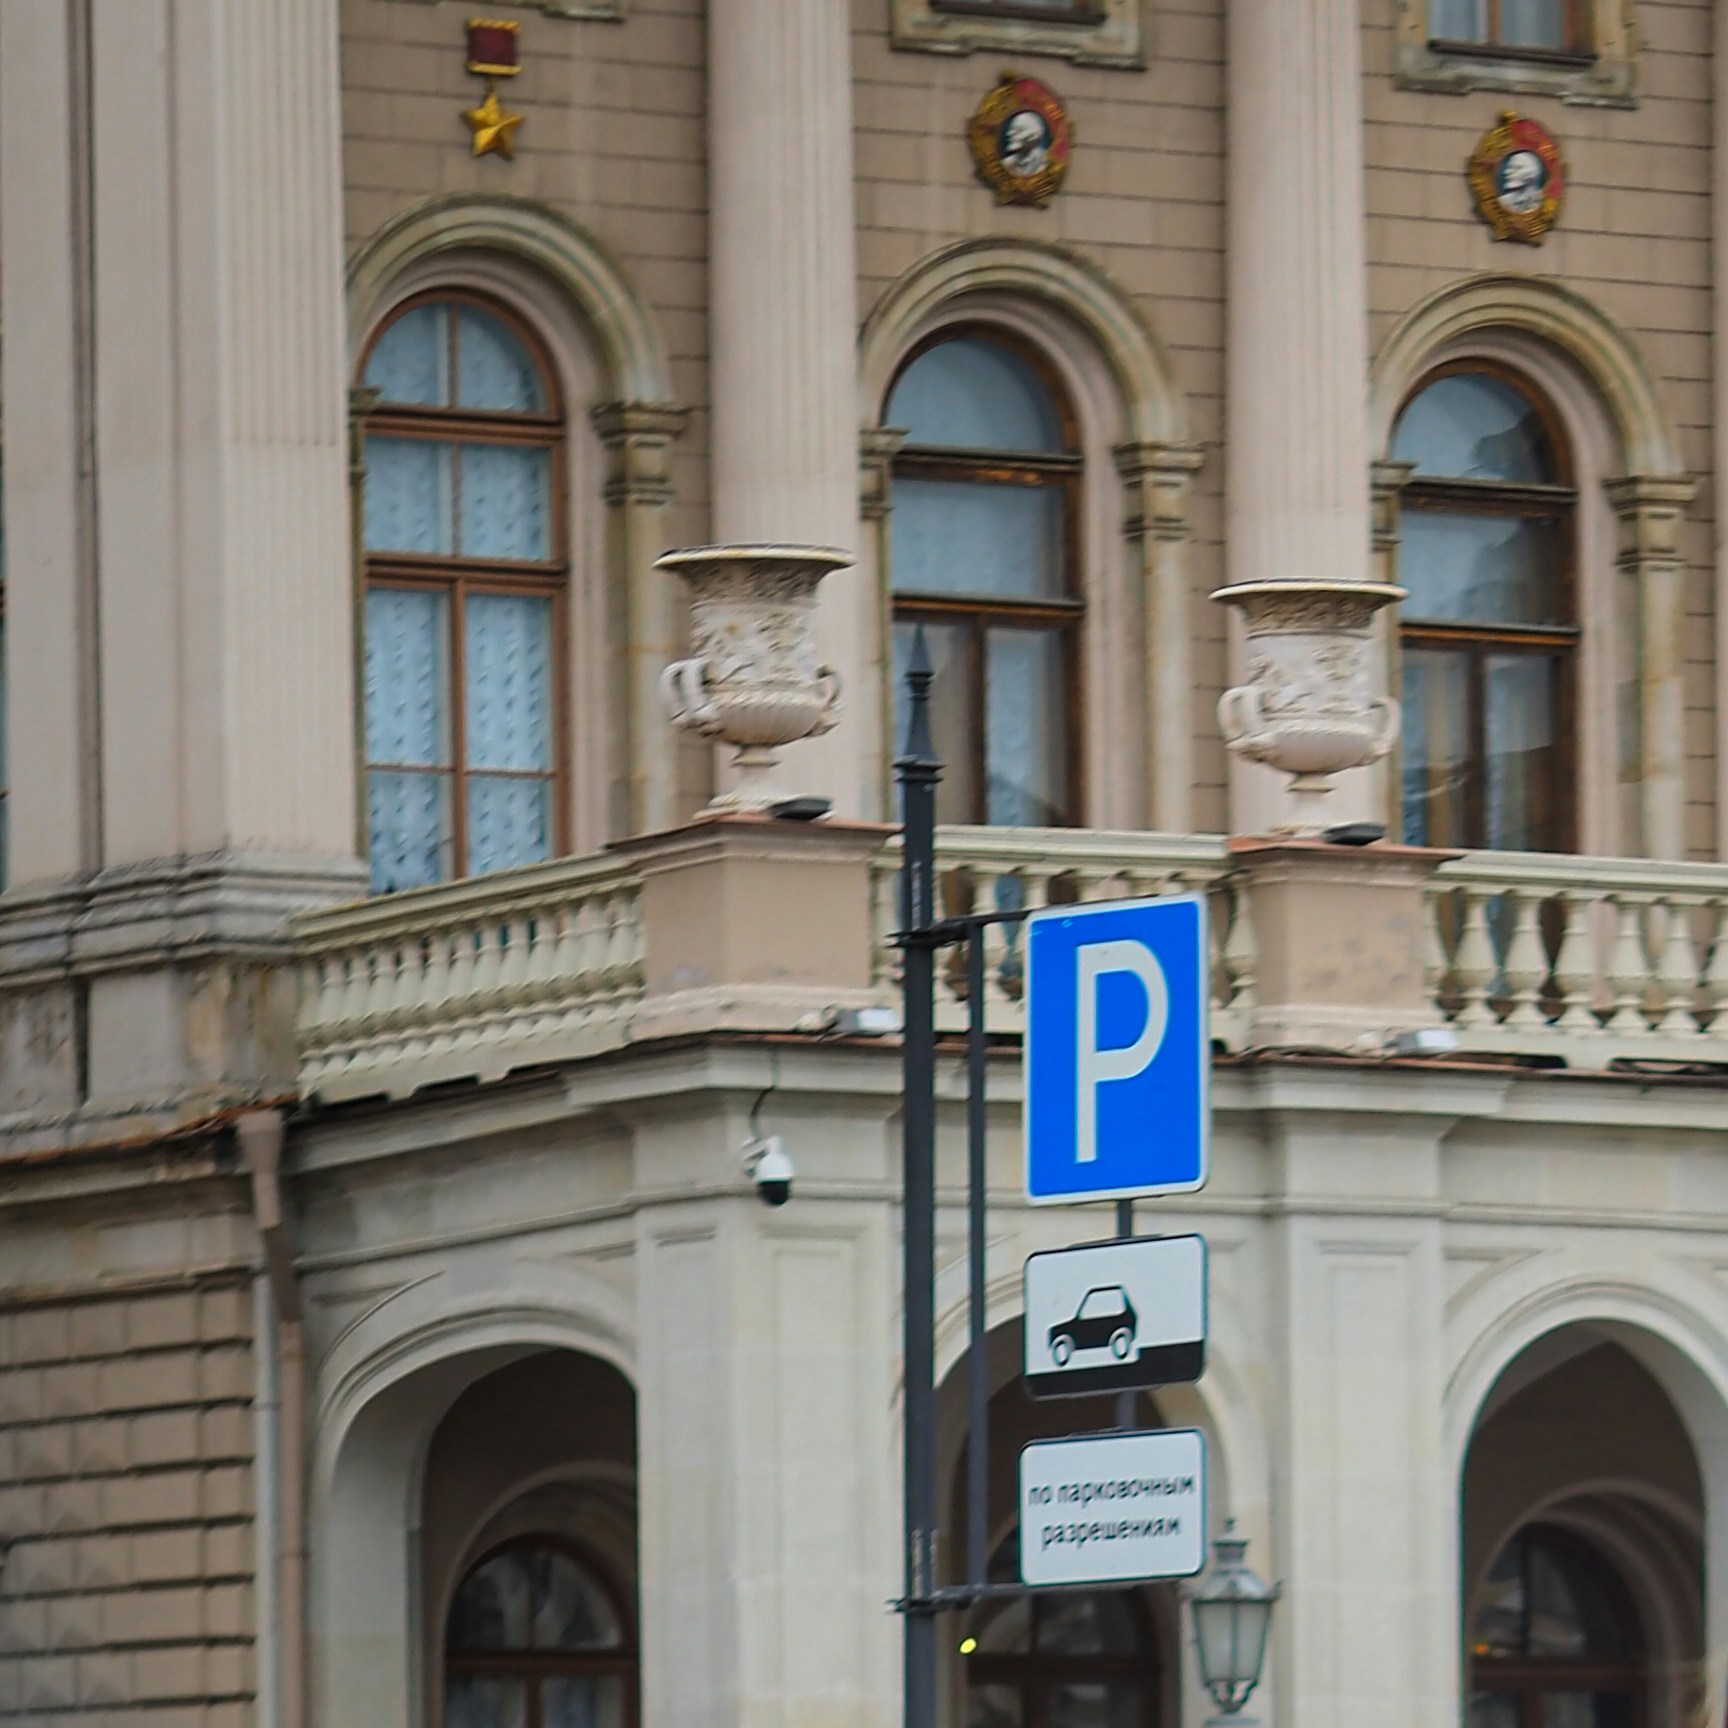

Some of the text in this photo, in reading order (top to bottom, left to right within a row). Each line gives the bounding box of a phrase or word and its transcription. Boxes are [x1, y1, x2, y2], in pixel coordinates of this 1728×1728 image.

[1075, 939, 1168, 1163] P
[1028, 1475, 1194, 1508] по парковочным
[1041, 1517, 1180, 1550] разрешениям
